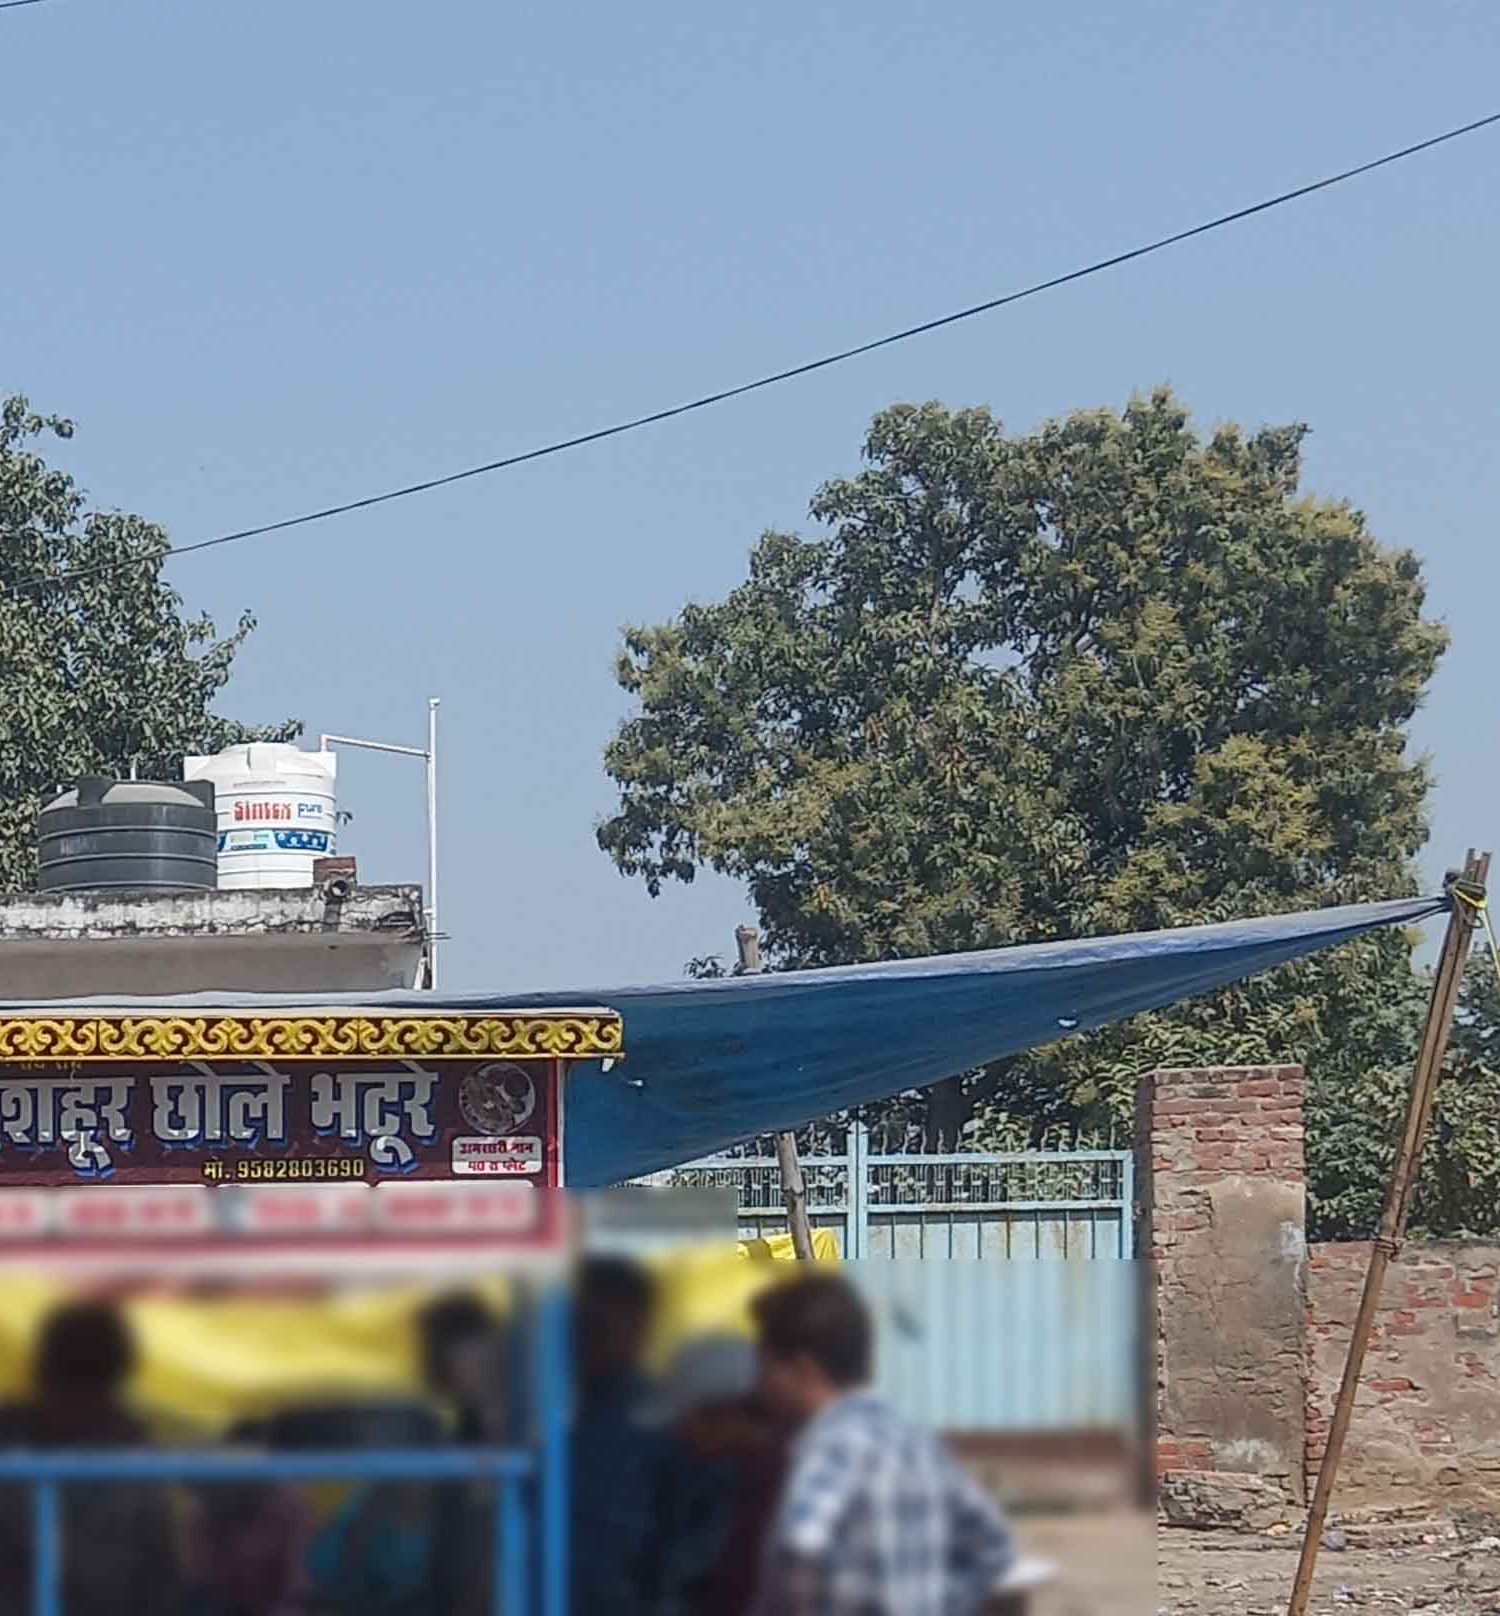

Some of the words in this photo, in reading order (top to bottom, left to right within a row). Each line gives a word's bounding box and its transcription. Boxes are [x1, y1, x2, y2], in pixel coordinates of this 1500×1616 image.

[149, 1060, 292, 1142] छोले
[311, 1060, 439, 1167] भटूरे
[237, 1159, 365, 1179] 9582803690
